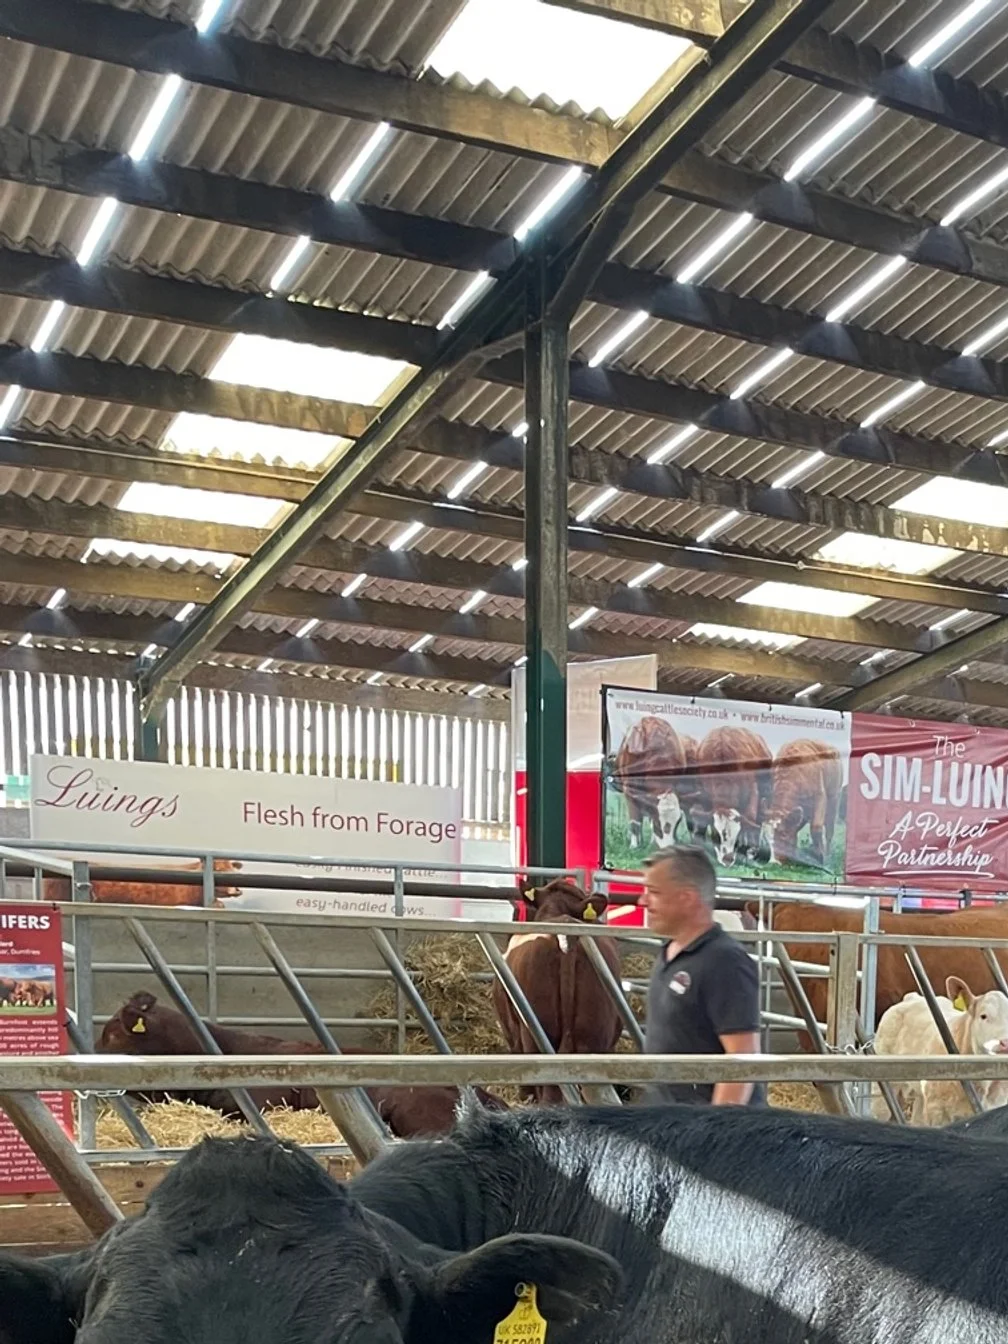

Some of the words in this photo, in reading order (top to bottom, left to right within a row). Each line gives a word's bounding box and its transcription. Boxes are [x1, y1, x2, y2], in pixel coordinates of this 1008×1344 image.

[615, 700, 729, 720] www.luingcattlesociety.co.uk
[932, 735, 966, 758] The
[34, 764, 179, 828] Luings
[243, 801, 304, 828] Flesh
[312, 806, 368, 833] from
[376, 812, 457, 844] Forage
[889, 810, 914, 840] A
[915, 811, 999, 848] Perfect
[877, 839, 994, 873] Partnership
[296, 897, 387, 914] easy-handled
[1, 914, 51, 930] IFERS
